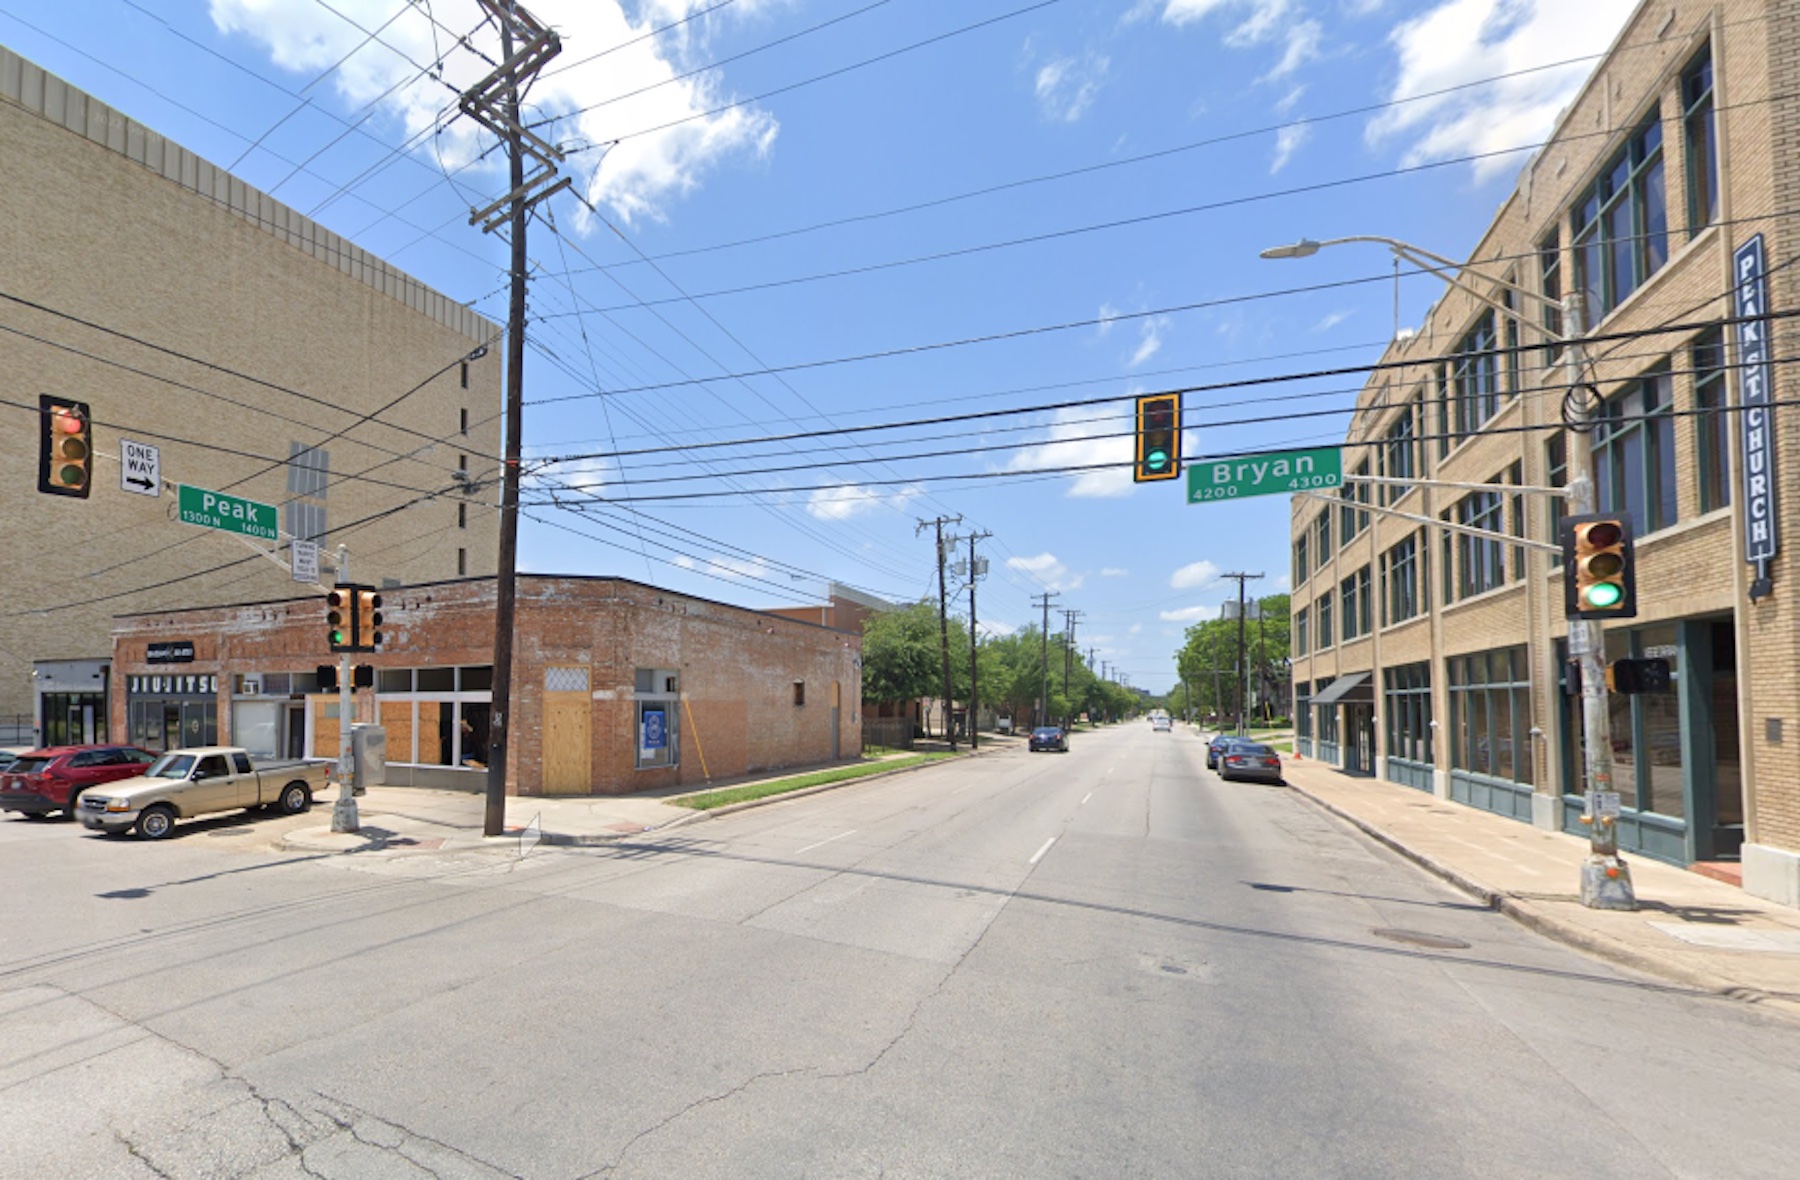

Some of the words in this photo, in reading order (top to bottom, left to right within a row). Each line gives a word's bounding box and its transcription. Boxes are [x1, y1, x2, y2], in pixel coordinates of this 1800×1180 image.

[1740, 254, 1758, 347] PEAK
[1746, 352, 1761, 398] ST
[127, 445, 153, 461] ONE
[128, 459, 155, 475] WAY
[1212, 456, 1314, 485] Bryan
[1748, 408, 1768, 543] CHURCH
[1193, 485, 1238, 500] 4200
[1288, 473, 1337, 489] 4300
[183, 510, 211, 525] 1300
[213, 516, 221, 527] N
[203, 493, 258, 522] Peak
[241, 522, 265, 537] 1400
[267, 527, 275, 538] N
